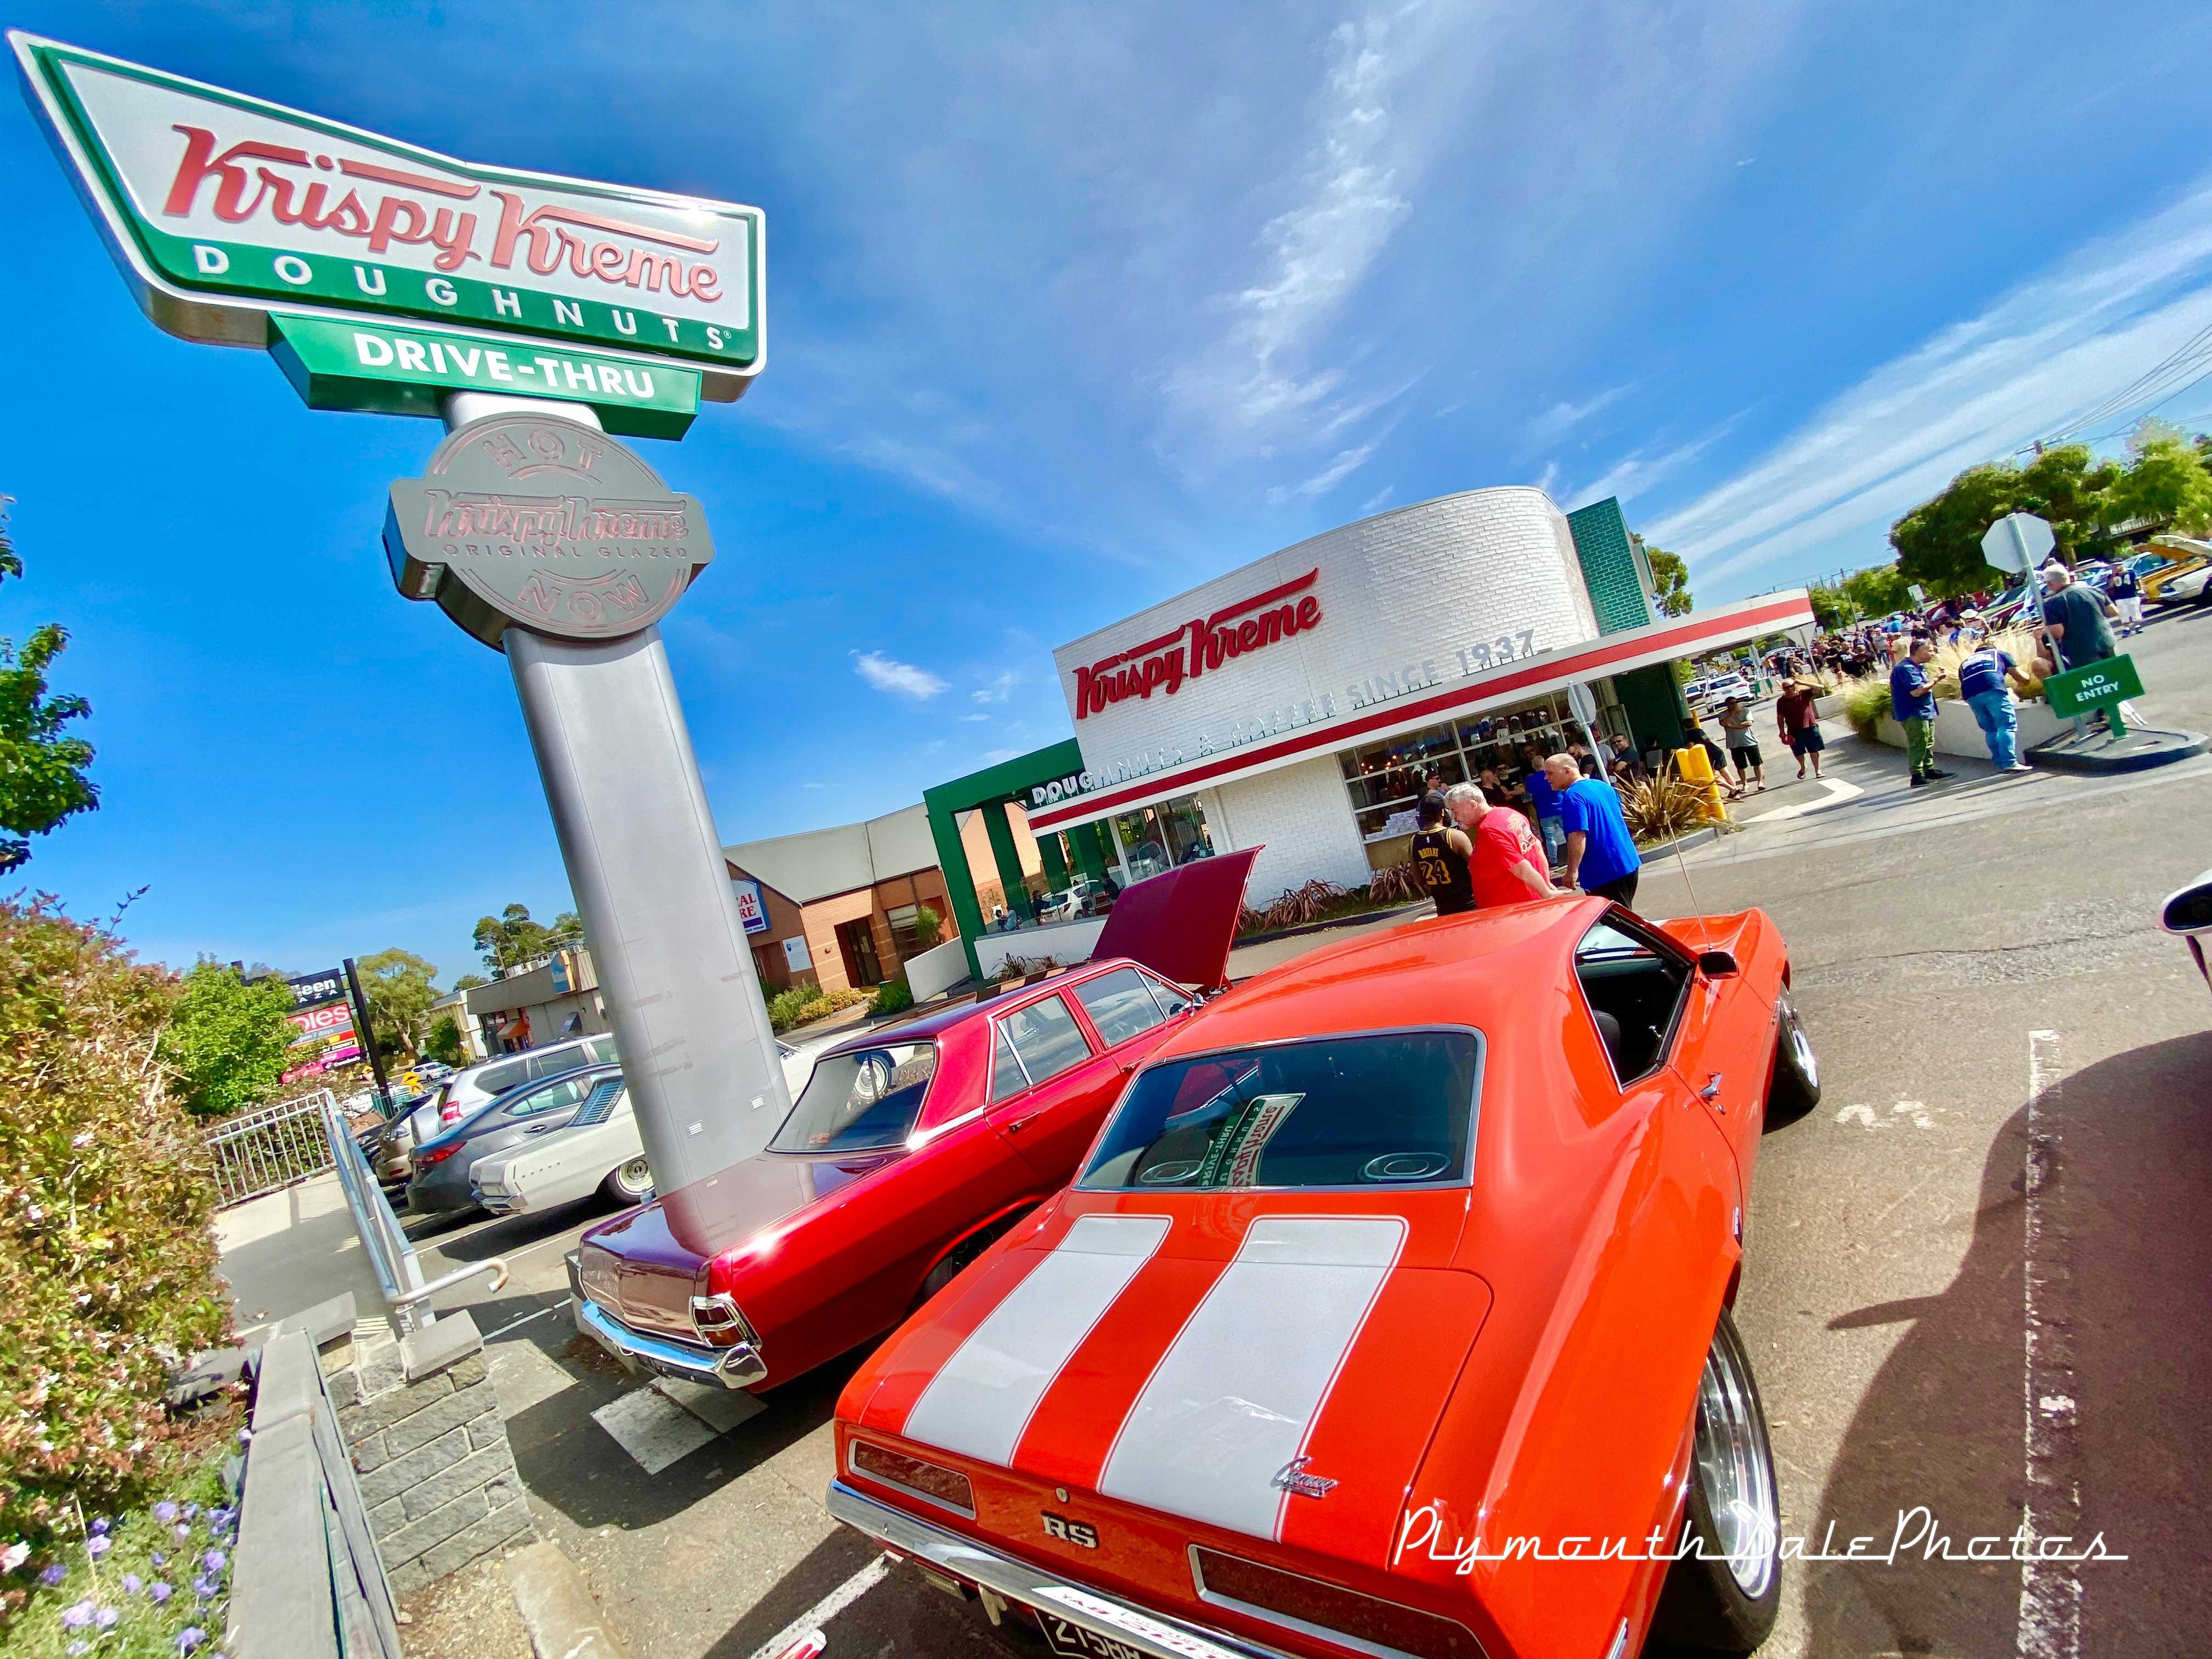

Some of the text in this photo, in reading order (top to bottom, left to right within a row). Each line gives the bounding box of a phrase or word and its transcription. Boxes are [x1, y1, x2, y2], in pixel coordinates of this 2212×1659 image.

[163, 124, 723, 302] Krispy Kreme
[195, 245, 724, 351] DOUGHNUTS
[355, 333, 655, 399] DRIVE-THRU
[484, 429, 604, 470] HOT
[425, 489, 689, 547] Krispy Kreme
[443, 544, 688, 559] ORIGINAL GLAZED
[518, 574, 650, 620] NOW
[1074, 566, 1323, 719] Krispy Kreme
[1346, 658, 1440, 705] SINCE
[1456, 628, 1536, 670] 1937
[2081, 675, 2104, 688] NO
[2076, 681, 2118, 702] ENTRY
[1418, 860, 1452, 884] 24
[739, 906, 756, 919] RE
[740, 893, 757, 906] AL
[299, 989, 338, 1003] AZA
[1042, 1515, 1097, 1548] RS
